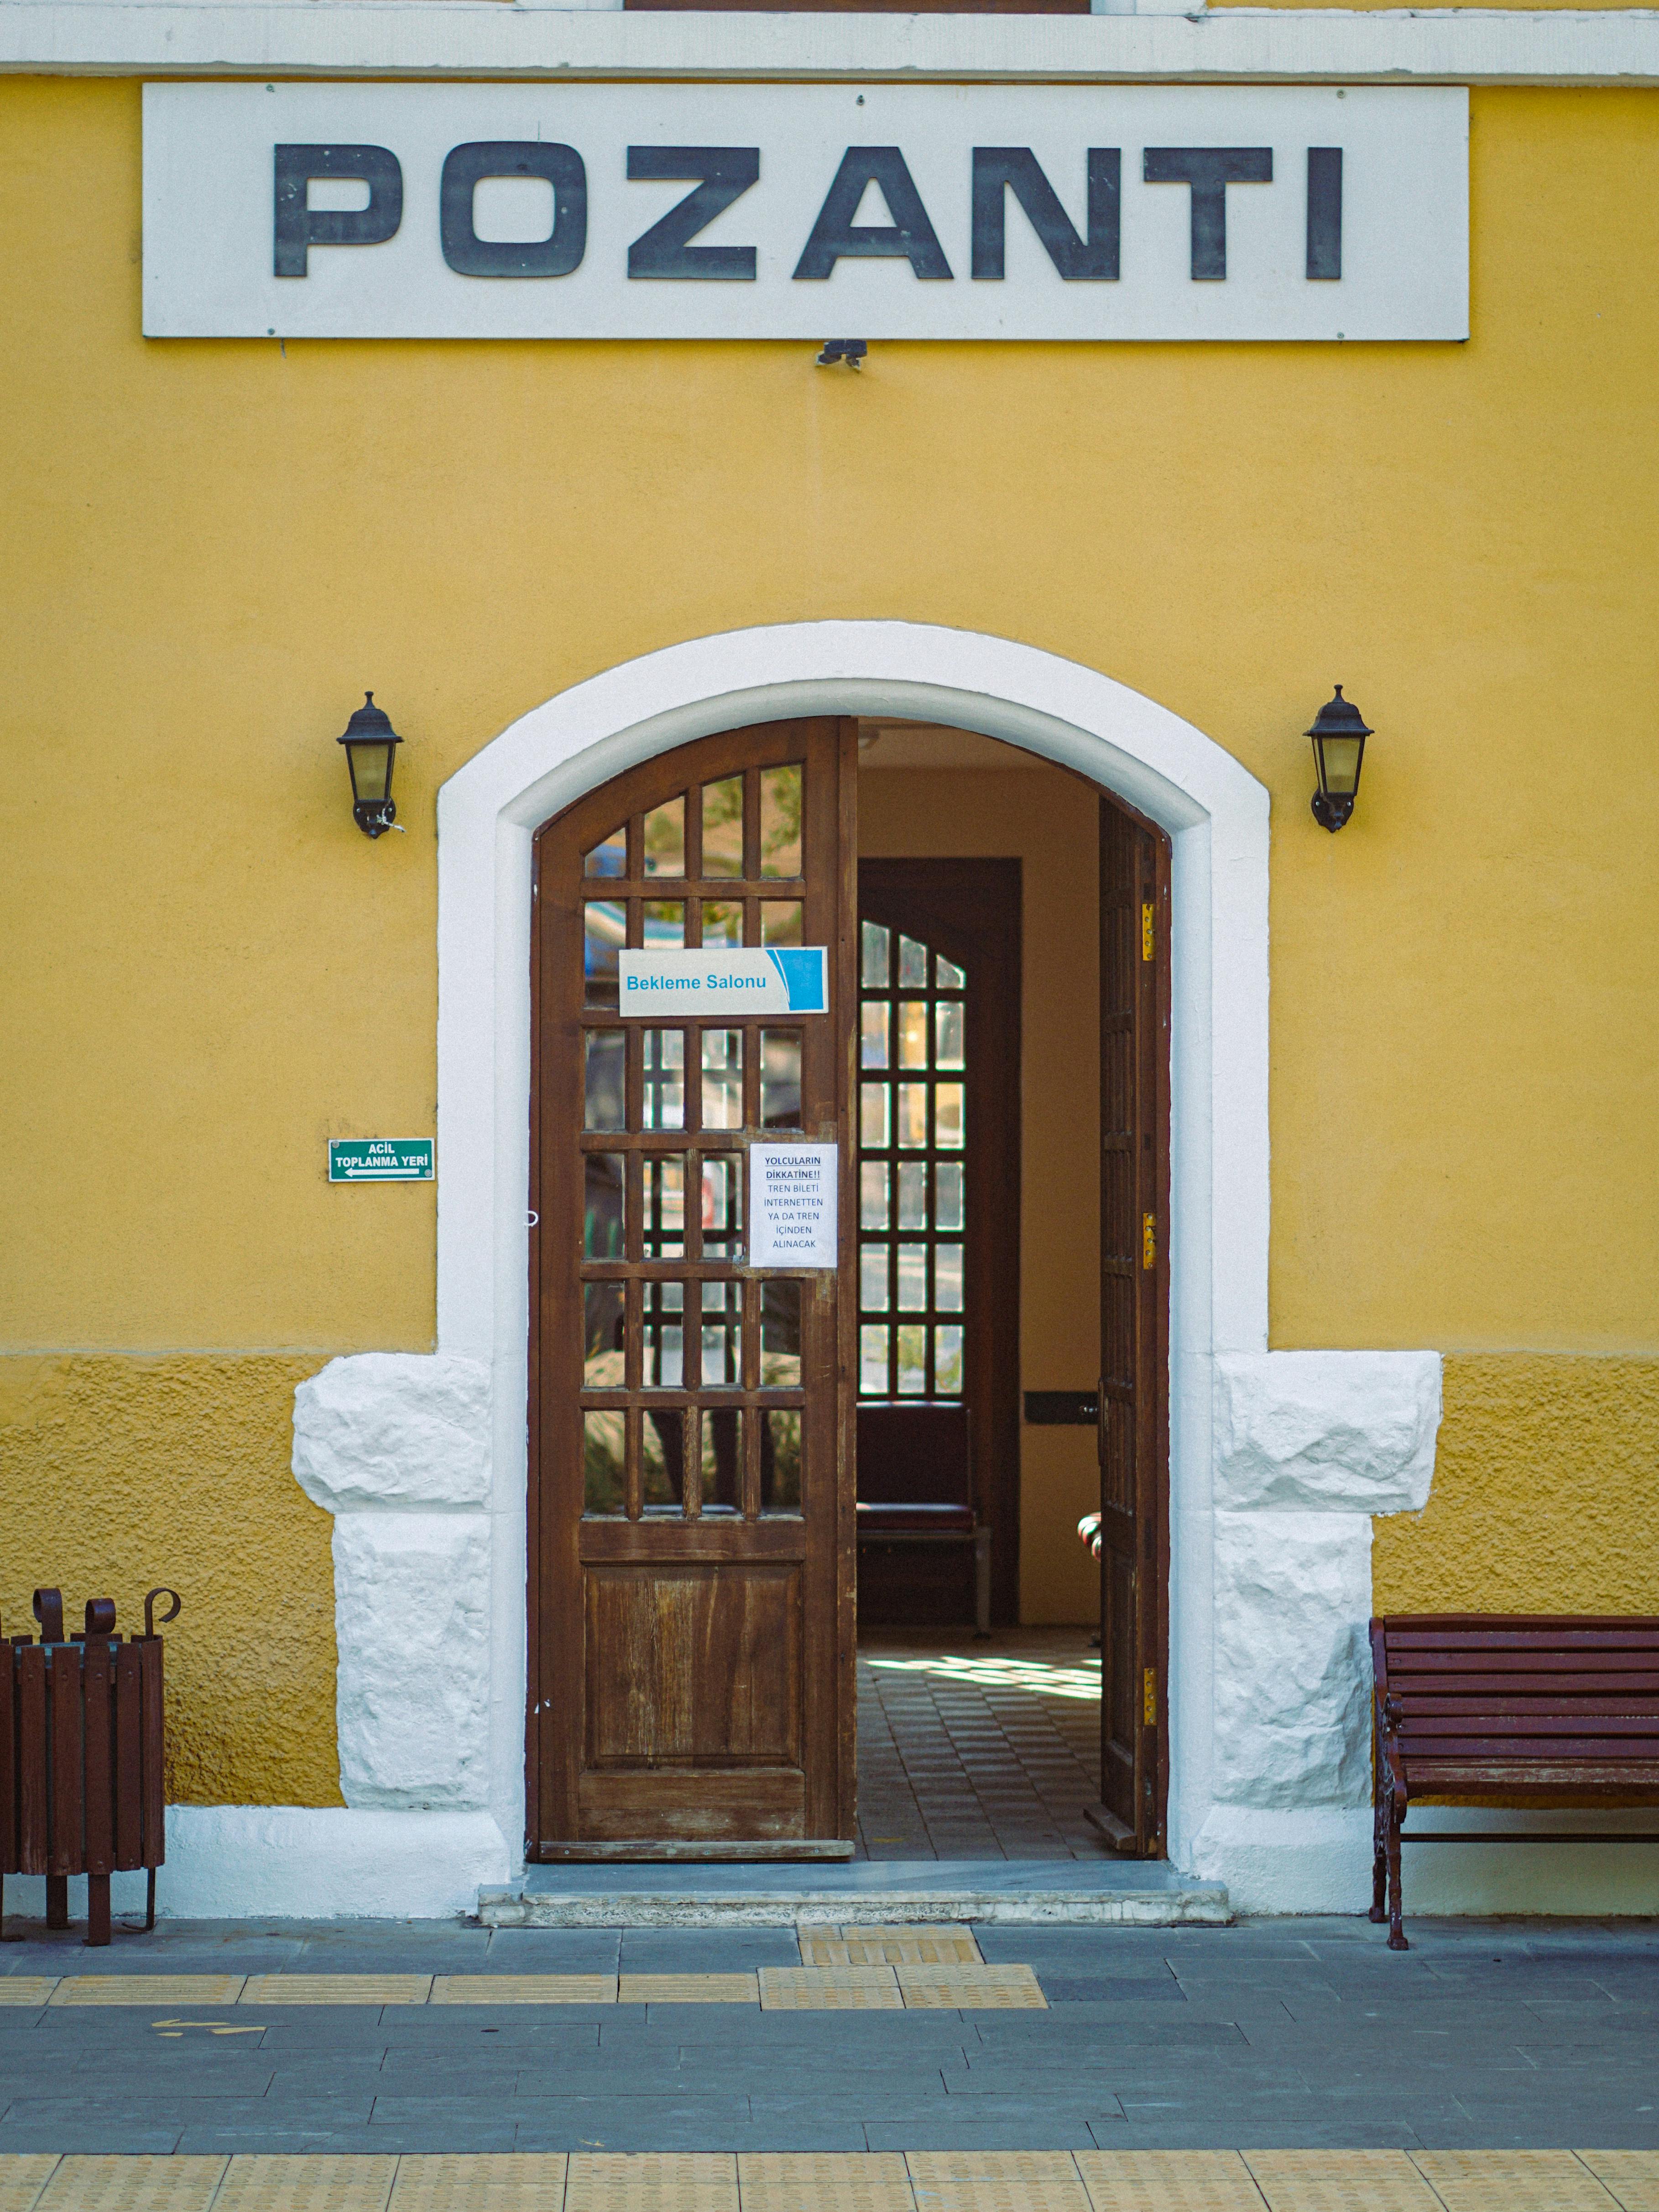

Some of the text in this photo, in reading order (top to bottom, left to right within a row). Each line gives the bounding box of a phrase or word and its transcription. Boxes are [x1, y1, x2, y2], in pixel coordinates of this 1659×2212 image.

[274, 141, 1342, 281] POZANTI
[627, 974, 767, 990] Bekleme Salonu
[368, 1141, 395, 1154] ACİL
[335, 1154, 428, 1167] TOPLANMA YERİ
[765, 1156, 821, 1165] YOLCULARIN
[766, 1169, 820, 1179] DİKKATİNE!!
[793, 1183, 819, 1192] BİLETİ
[764, 1197, 823, 1207] İNTERNETTEN
[776, 1225, 812, 1236] İÇİNDEN
[772, 1240, 816, 1248] ALINACAK
